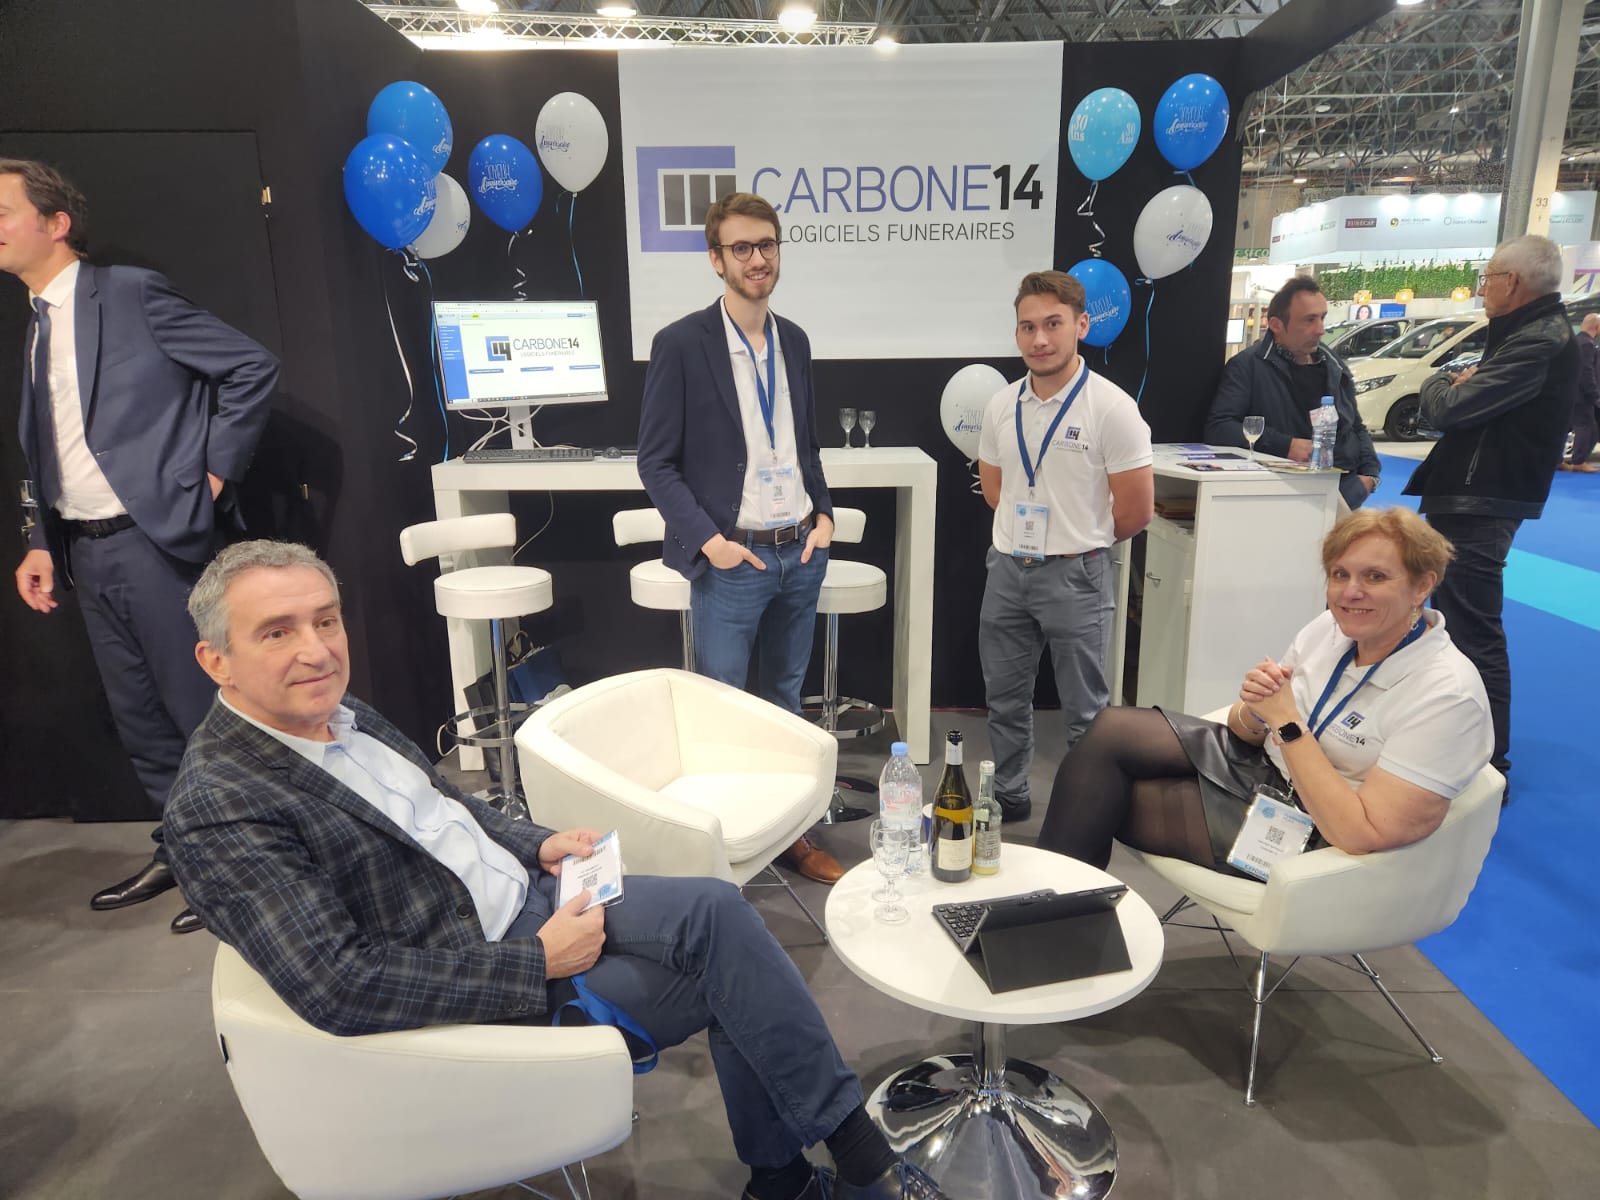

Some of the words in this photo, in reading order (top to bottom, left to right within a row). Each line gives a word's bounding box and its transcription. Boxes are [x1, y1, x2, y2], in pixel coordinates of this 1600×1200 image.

[1073, 114, 1088, 132] 30
[751, 163, 1044, 214] CARBONE14
[1535, 196, 1549, 208] 33
[781, 223, 880, 243] OGICIELS
[887, 222, 1015, 242] FUNERAIRES
[513, 337, 579, 350] CARBONE14
